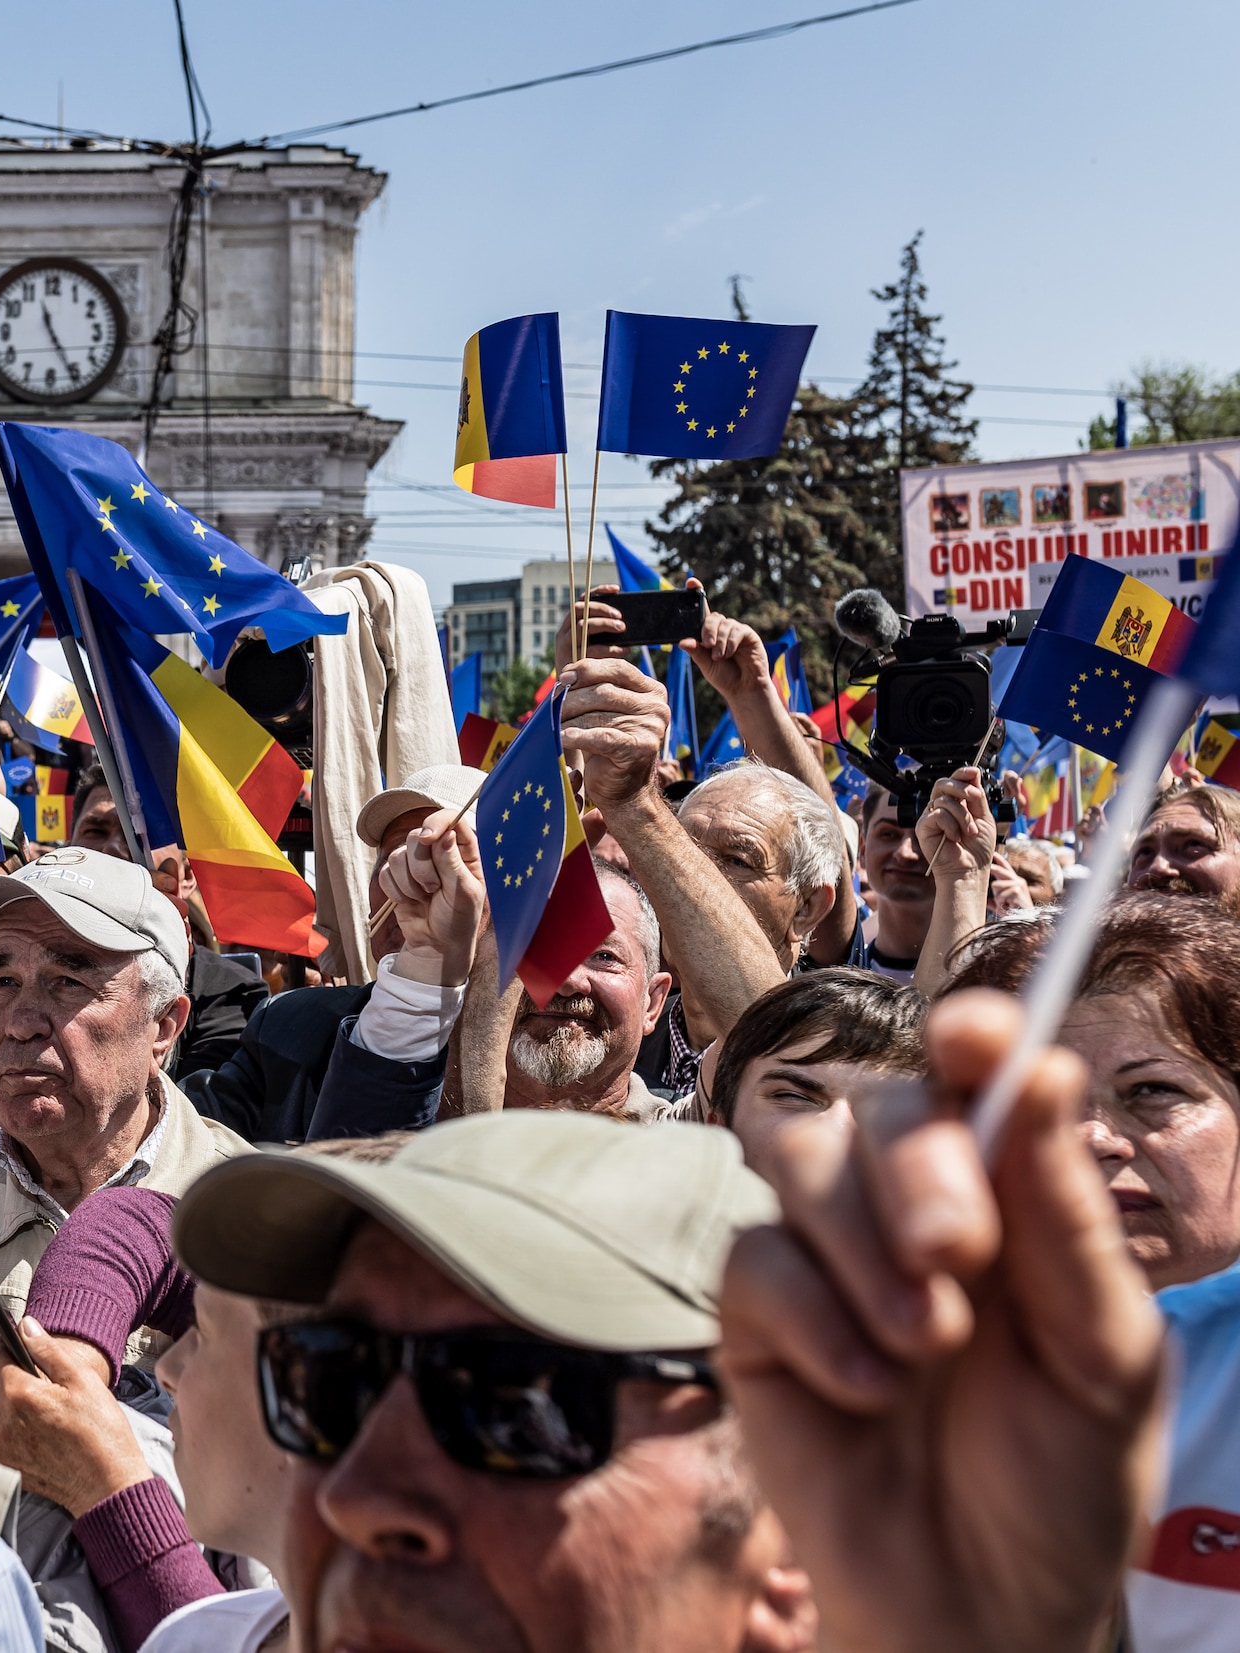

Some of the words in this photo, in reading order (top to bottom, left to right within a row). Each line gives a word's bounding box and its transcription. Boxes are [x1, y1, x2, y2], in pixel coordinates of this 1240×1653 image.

[23, 282, 35, 302] 11
[45, 276, 61, 296] 12
[72, 285, 79, 303] 1
[6, 300, 22, 318] 10
[85, 300, 96, 319] 2
[92, 322, 102, 342] 3
[23, 362, 33, 382] 7
[970, 577, 1024, 612] DIN
